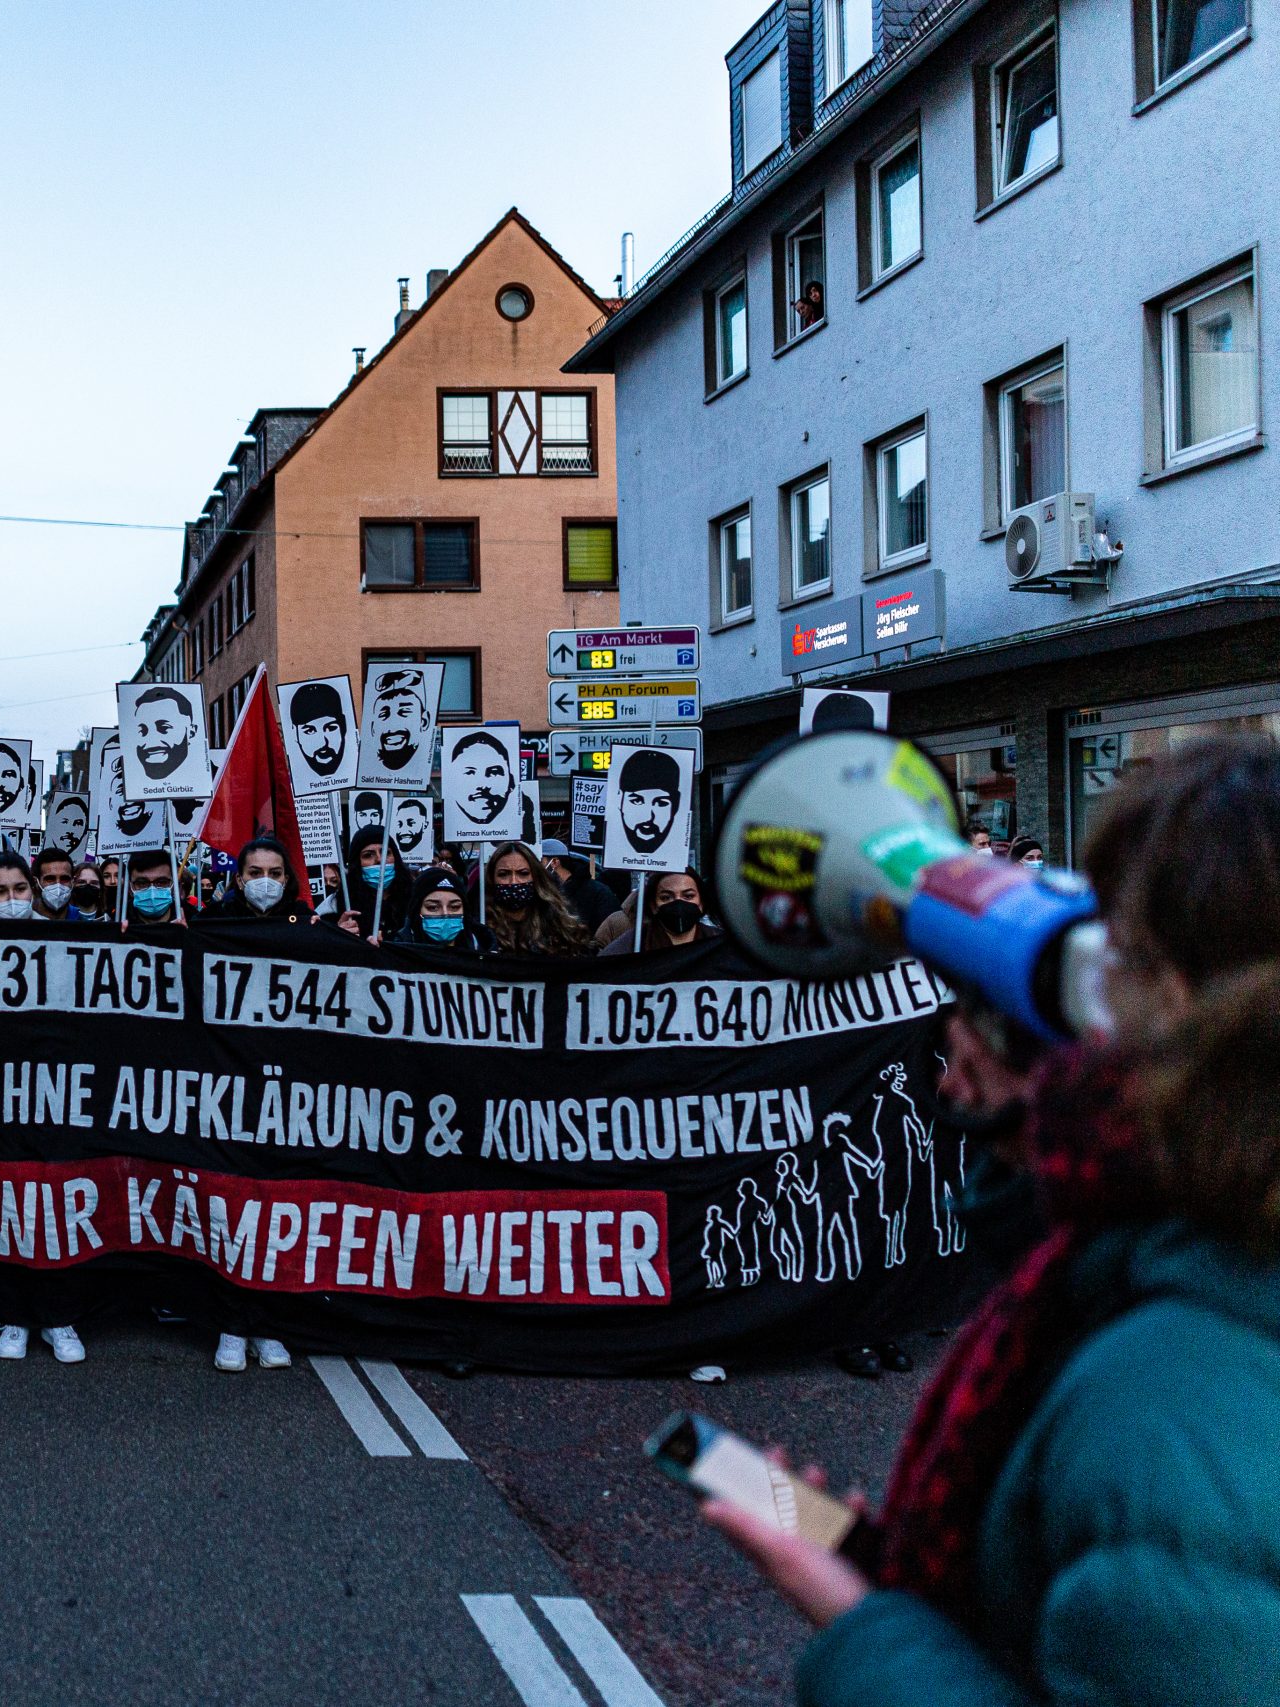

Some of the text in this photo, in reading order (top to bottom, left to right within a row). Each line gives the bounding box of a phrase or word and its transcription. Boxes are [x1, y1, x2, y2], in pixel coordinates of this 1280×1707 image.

[876, 604, 920, 625] Jörg Fleischer
[816, 621, 847, 638] Sparkassen
[578, 633, 663, 646] TG Am Markt
[813, 633, 848, 651] Versicherung
[591, 650, 614, 669] 83
[620, 653, 636, 665] frei
[578, 684, 670, 697] PH Am Forum
[581, 701, 615, 720] 385
[621, 704, 637, 716] frei
[579, 734, 668, 747] PH Kinopoli 2
[309, 777, 349, 789] Ferhat Unvar
[361, 775, 424, 786] Said Nesar Hashemi
[575, 780, 605, 796] #say
[143, 785, 194, 795] Sedat Gürbüz
[575, 793, 601, 804] their
[574, 803, 606, 814] name
[481, 828, 509, 837] Kurtović
[101, 839, 159, 851] Said Nesar Hashemi
[217, 851, 234, 866] 3.
[622, 857, 668, 867] Ferhat Unvar
[66, 946, 181, 1014] TAGE
[209, 959, 538, 1044] 17.544 STUNDEN
[575, 985, 771, 1045] 1.052.640
[108, 1064, 415, 1154] AUFKLÄRUNG
[425, 1093, 463, 1158] &
[480, 1085, 815, 1162] KONSEQUENZEN
[127, 1168, 421, 1291] KÄMPFEN
[442, 1209, 667, 1298] WEITER
